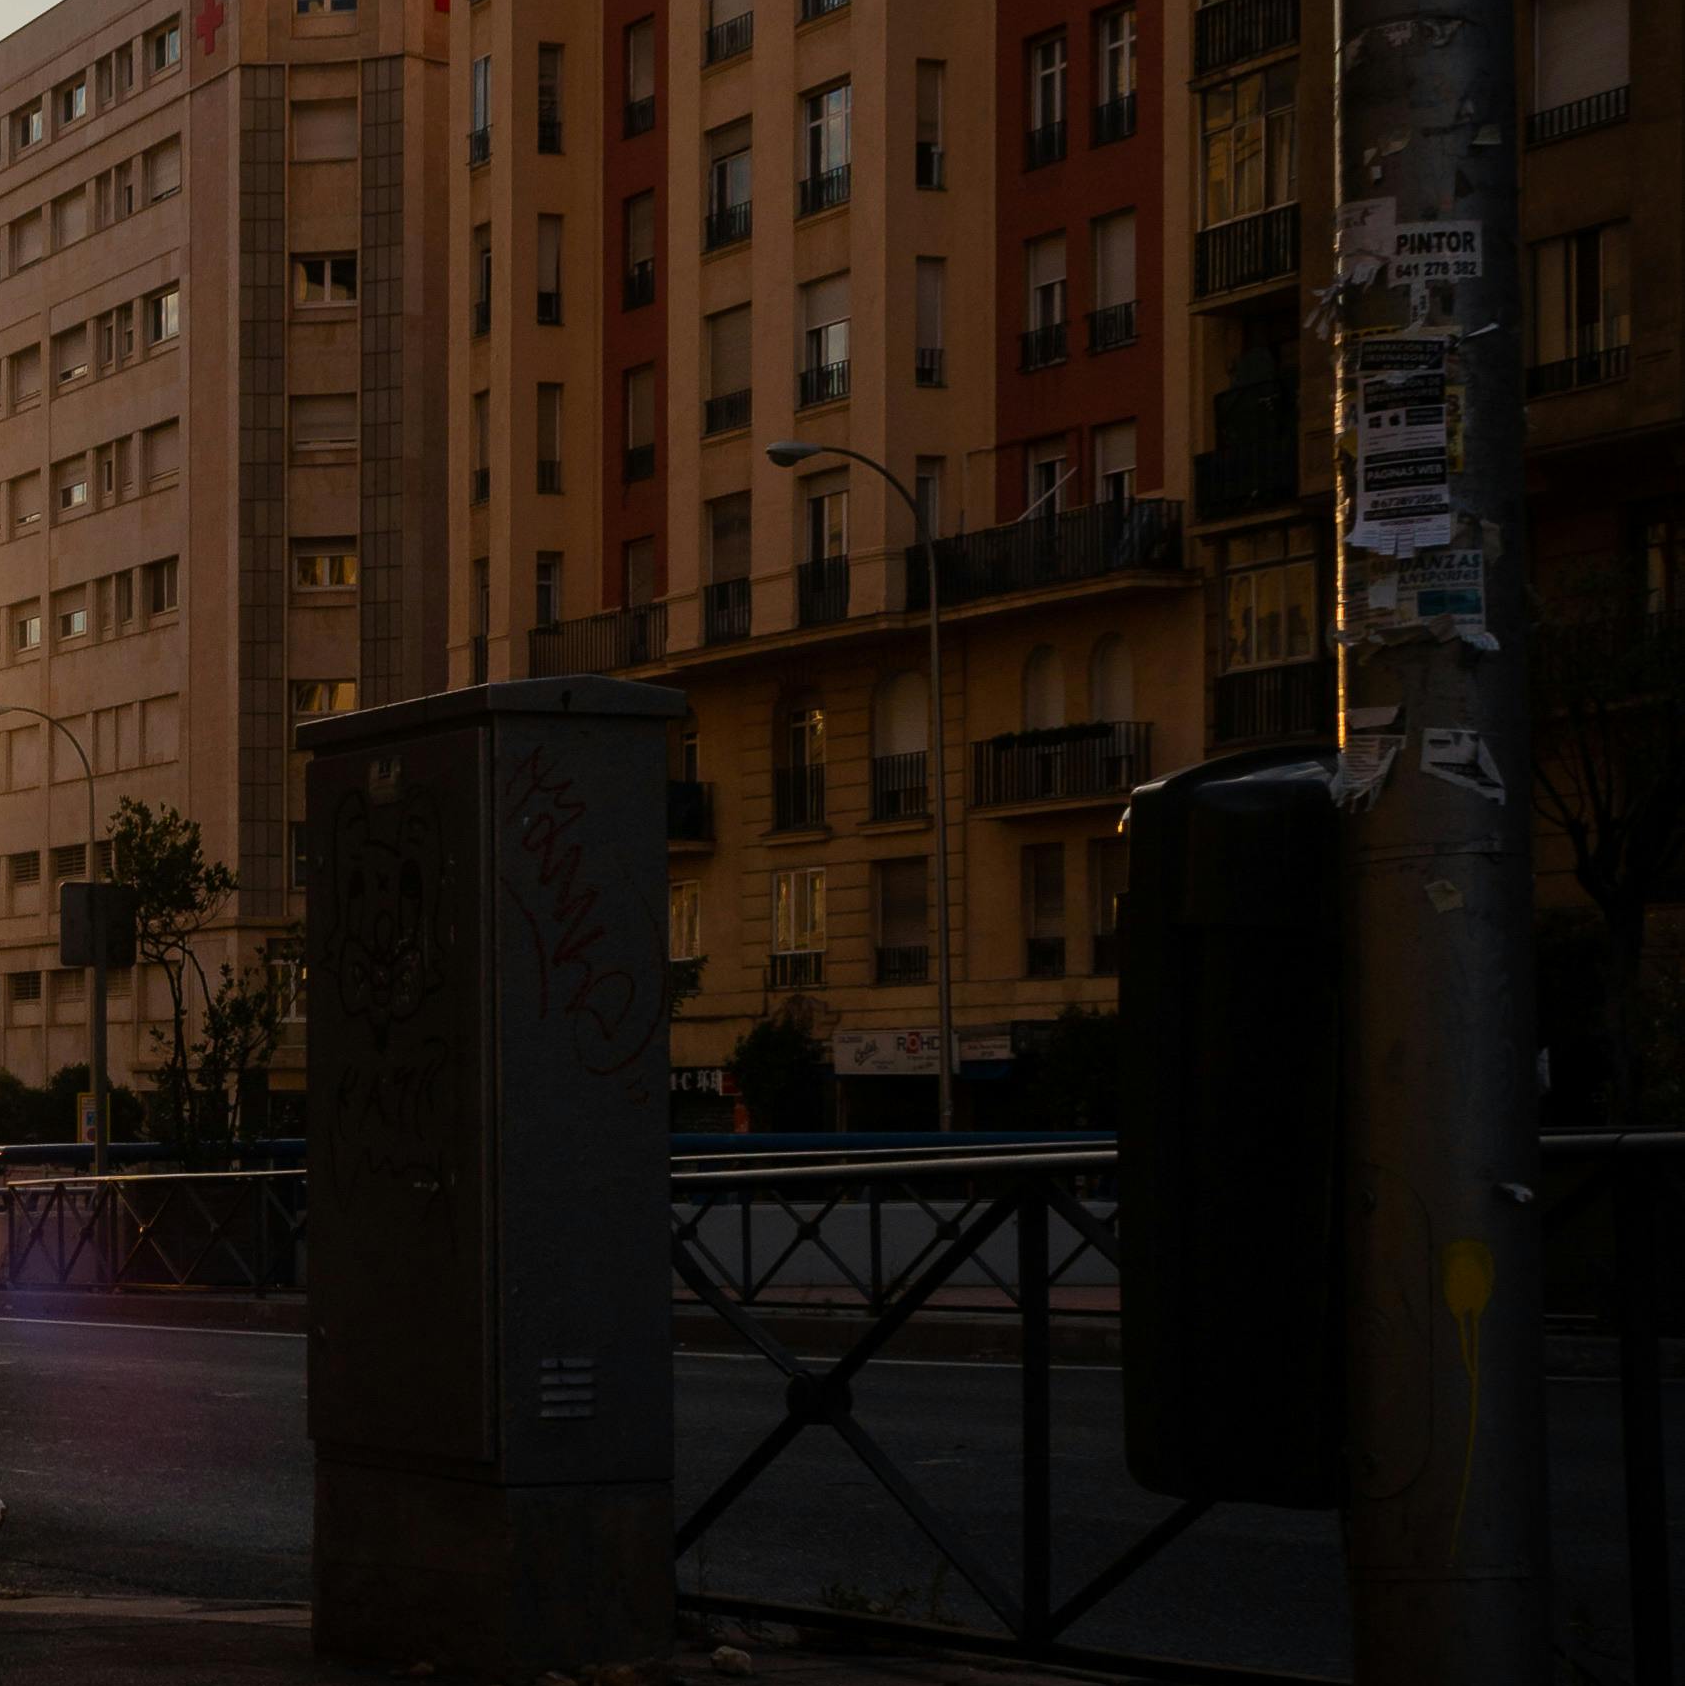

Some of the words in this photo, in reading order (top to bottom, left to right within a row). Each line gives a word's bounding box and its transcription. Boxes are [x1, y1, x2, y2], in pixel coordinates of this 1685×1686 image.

[1395, 231, 1476, 255] PINTOR
[1395, 264, 1419, 278] 641
[1424, 261, 1450, 276] 278
